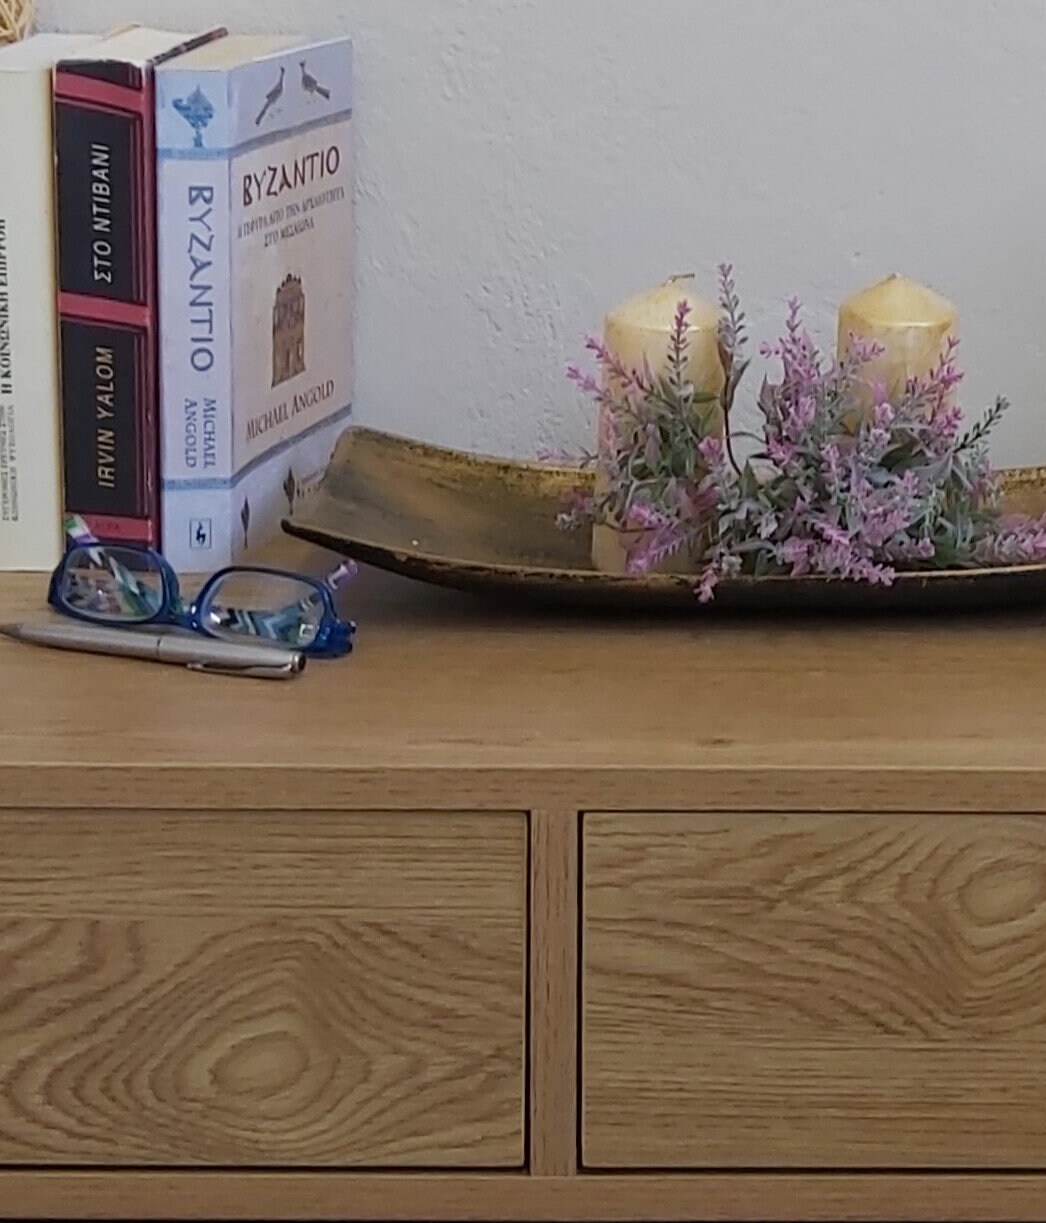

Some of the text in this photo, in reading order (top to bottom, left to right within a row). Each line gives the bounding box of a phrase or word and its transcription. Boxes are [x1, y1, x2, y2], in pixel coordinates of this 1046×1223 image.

[243, 145, 340, 207] ΒΥΖΑΝΤΙΟ
[91, 143, 113, 284] ΣΤΟ ΝΤΙΒΑΝΙ
[187, 186, 215, 372] ΒΥΖΑΝΤΙΟ
[95, 346, 116, 488] IRVIN YALOM
[184, 397, 198, 469] ANGOLD
[203, 397, 217, 469] MICHAEL
[246, 379, 335, 442] MICHAEL ANGOLD
